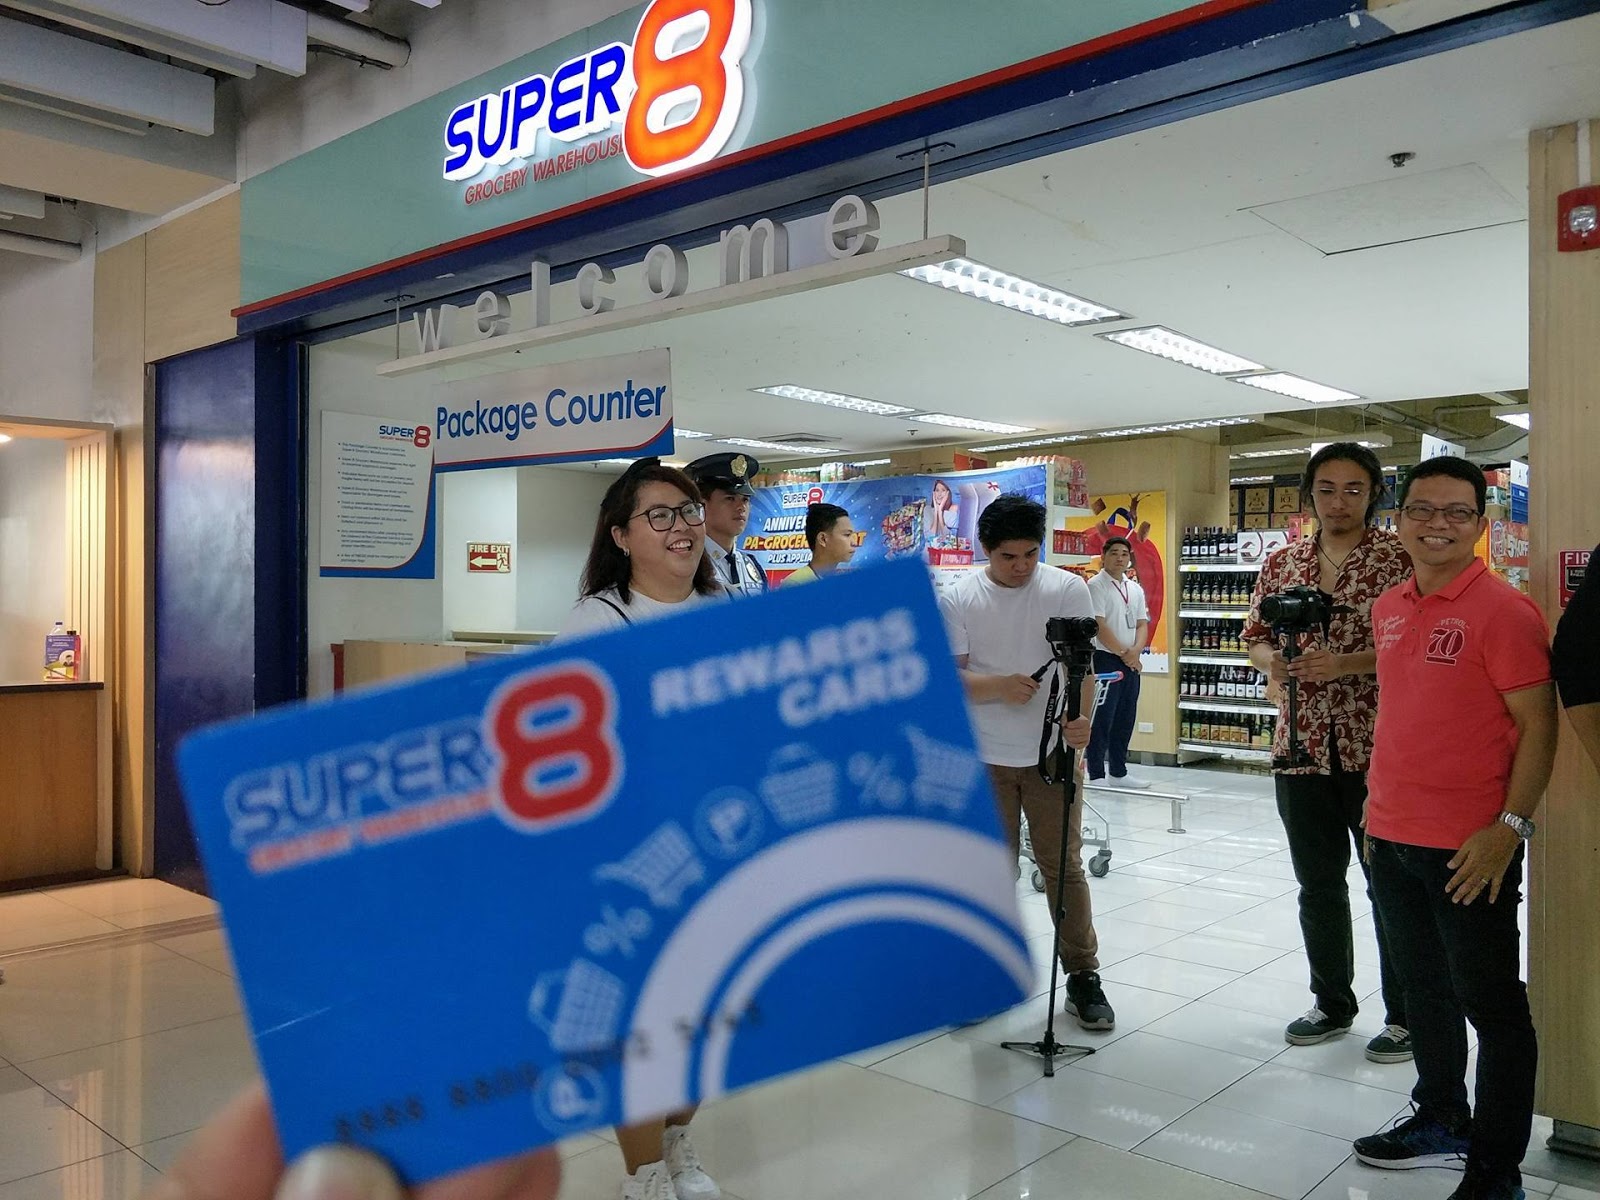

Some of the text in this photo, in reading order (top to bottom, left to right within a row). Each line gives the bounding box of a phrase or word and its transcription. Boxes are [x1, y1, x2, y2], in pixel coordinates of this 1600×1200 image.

[443, 44, 627, 175] SUPER
[464, 167, 529, 205] GROCERY
[413, 195, 880, 354] welcome
[436, 379, 667, 441] Package Counter
[379, 425, 414, 438] SUPER
[469, 544, 510, 553] FIRE EXIT
[742, 534, 810, 549] PA-GROCER
[785, 552, 813, 563] APPLIA
[1564, 552, 1591, 565] FIR
[1426, 627, 1465, 657] 70
[651, 607, 930, 728] REWARDS CARD
[226, 719, 496, 848] SUPER
